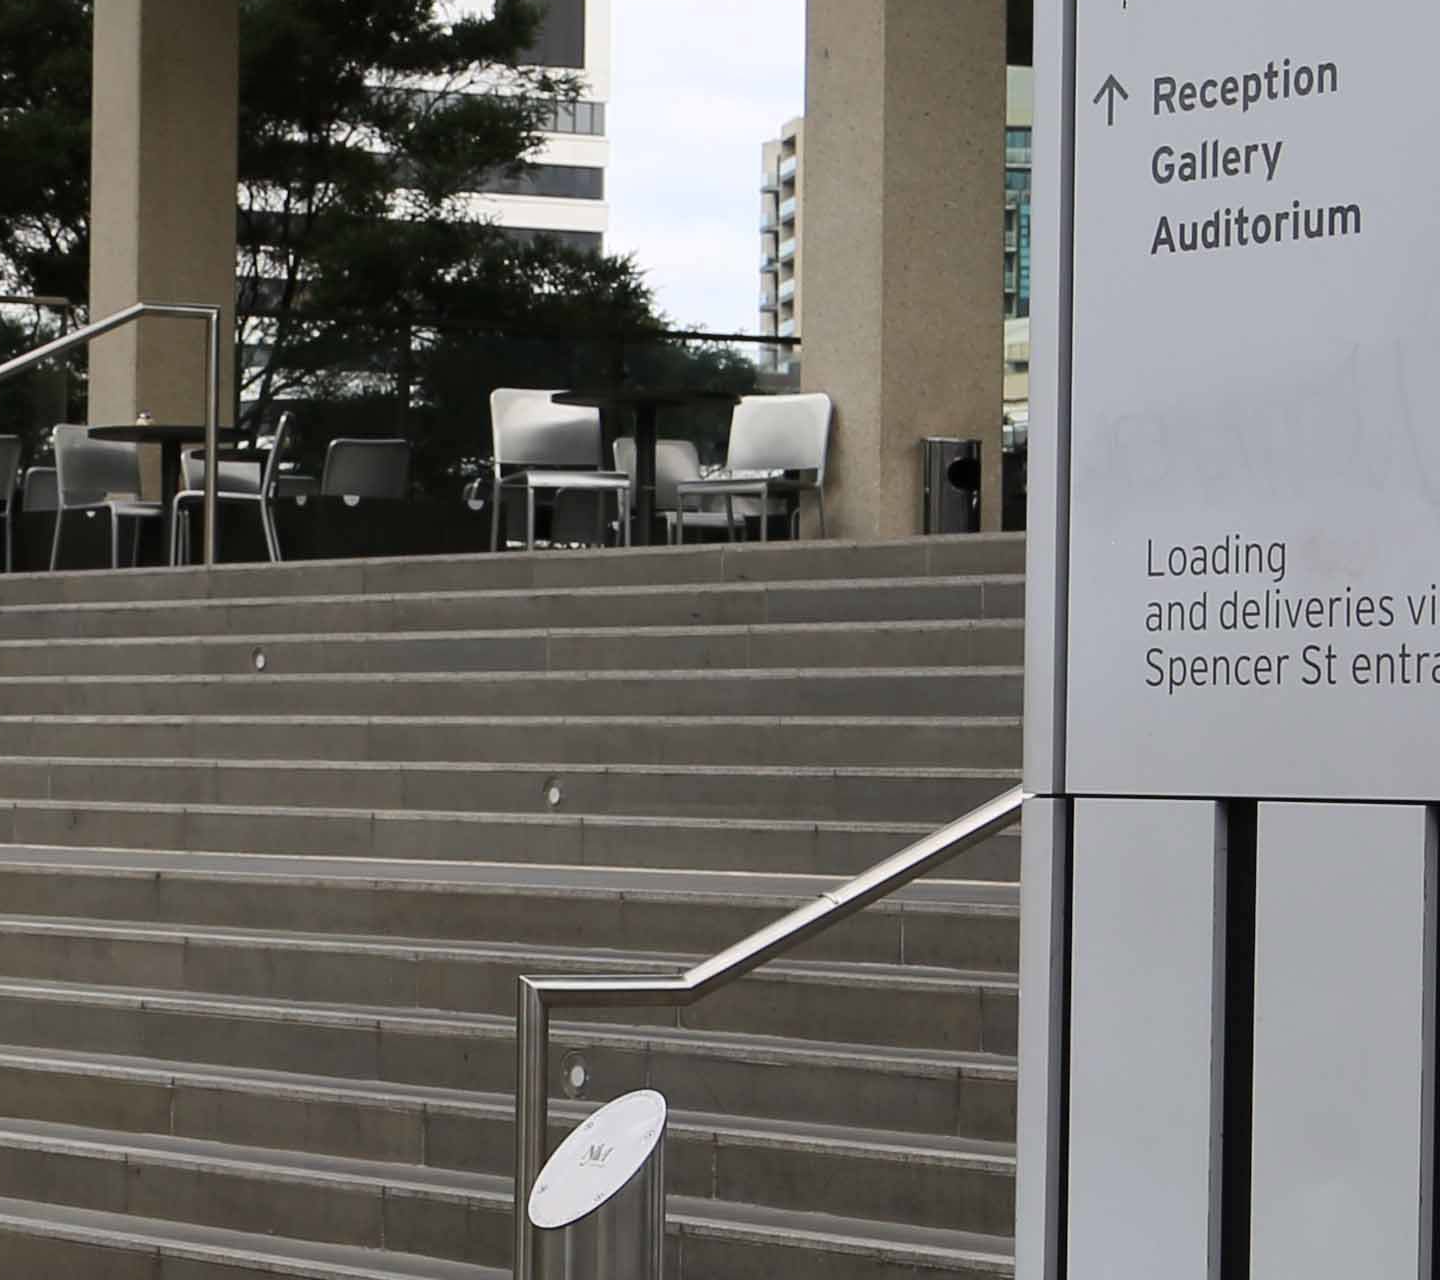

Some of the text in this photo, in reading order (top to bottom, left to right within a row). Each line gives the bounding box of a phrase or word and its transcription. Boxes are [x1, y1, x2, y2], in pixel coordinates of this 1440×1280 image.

[1153, 57, 1338, 116] Reception
[1151, 138, 1284, 185] Gallery
[1150, 199, 1361, 256] Auditorium
[1147, 533, 1286, 584] Loading
[1145, 591, 1208, 633] and
[1219, 585, 1395, 631] deliveries
[1144, 647, 1291, 696] Spencer
[1301, 643, 1338, 686] St
